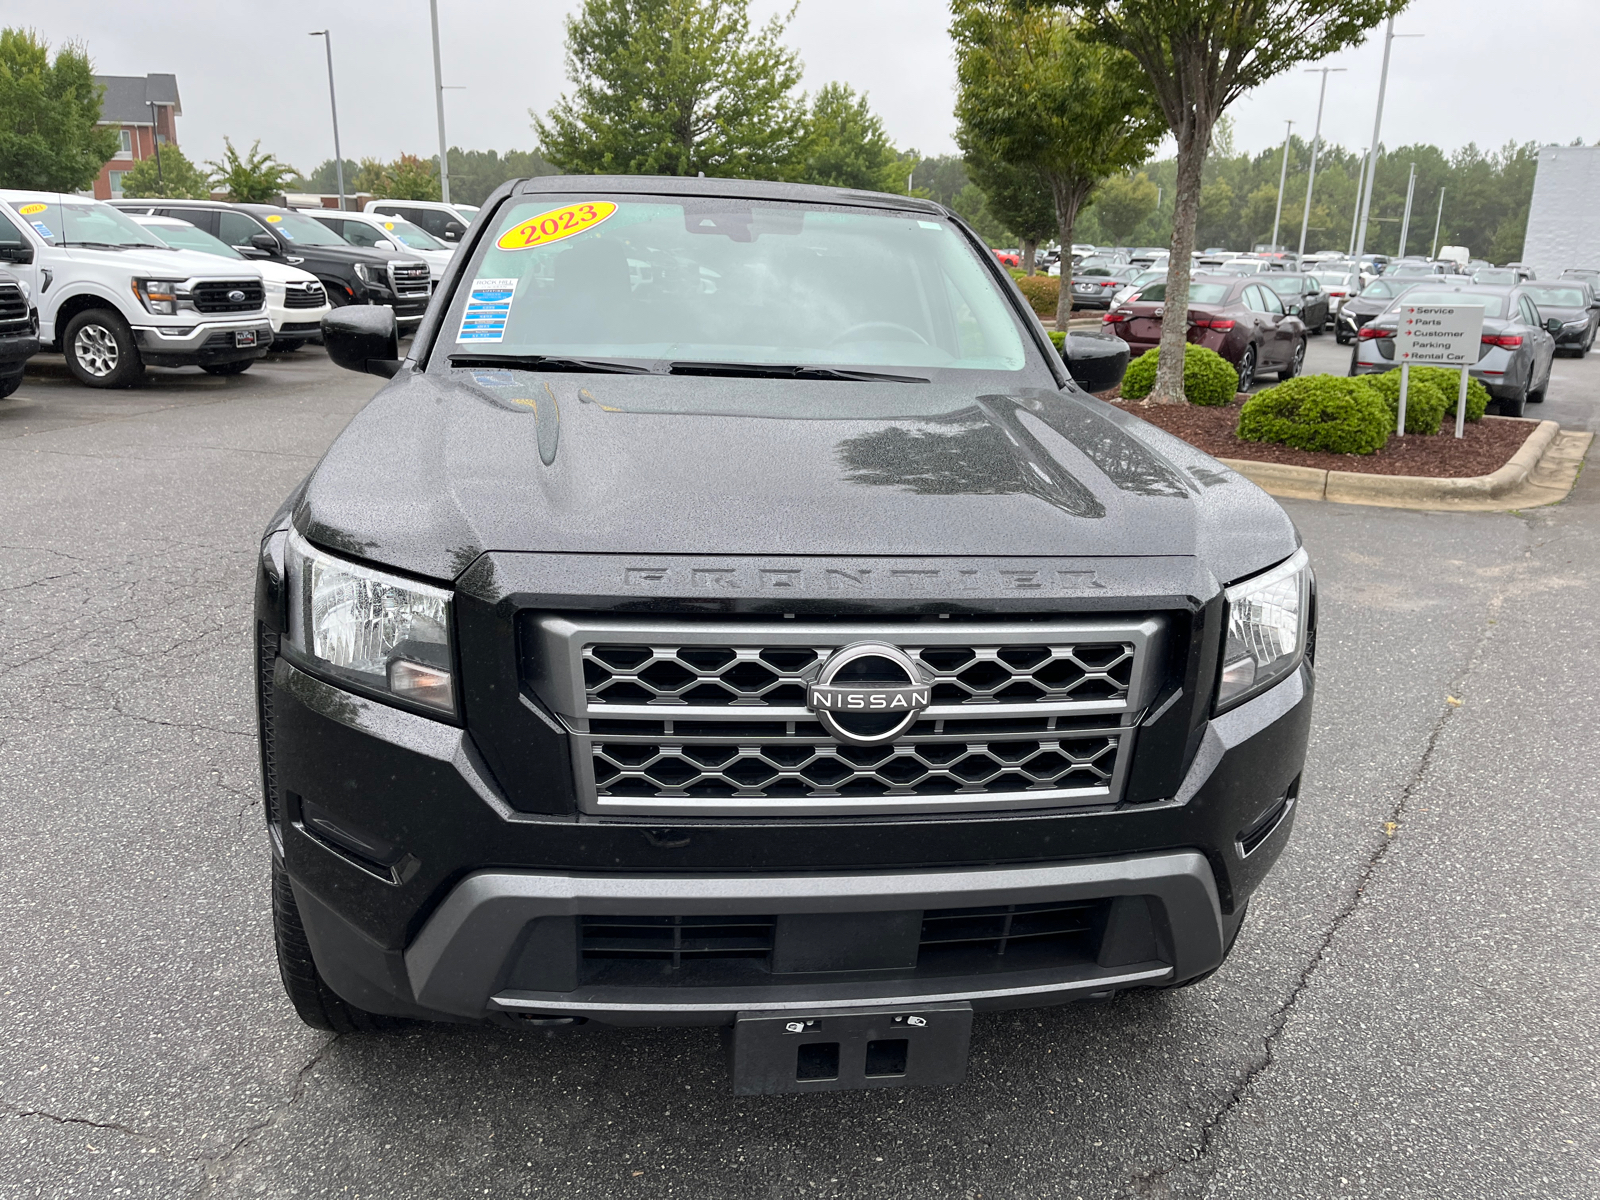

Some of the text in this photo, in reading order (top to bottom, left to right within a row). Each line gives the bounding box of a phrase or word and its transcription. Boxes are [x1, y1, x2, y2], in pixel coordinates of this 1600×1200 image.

[520, 205, 598, 245] 2023
[1415, 318, 1442, 326] Parts
[1412, 341, 1451, 350] Parking
[624, 567, 1107, 590] FRONTIER
[813, 690, 928, 709] NISSAN
